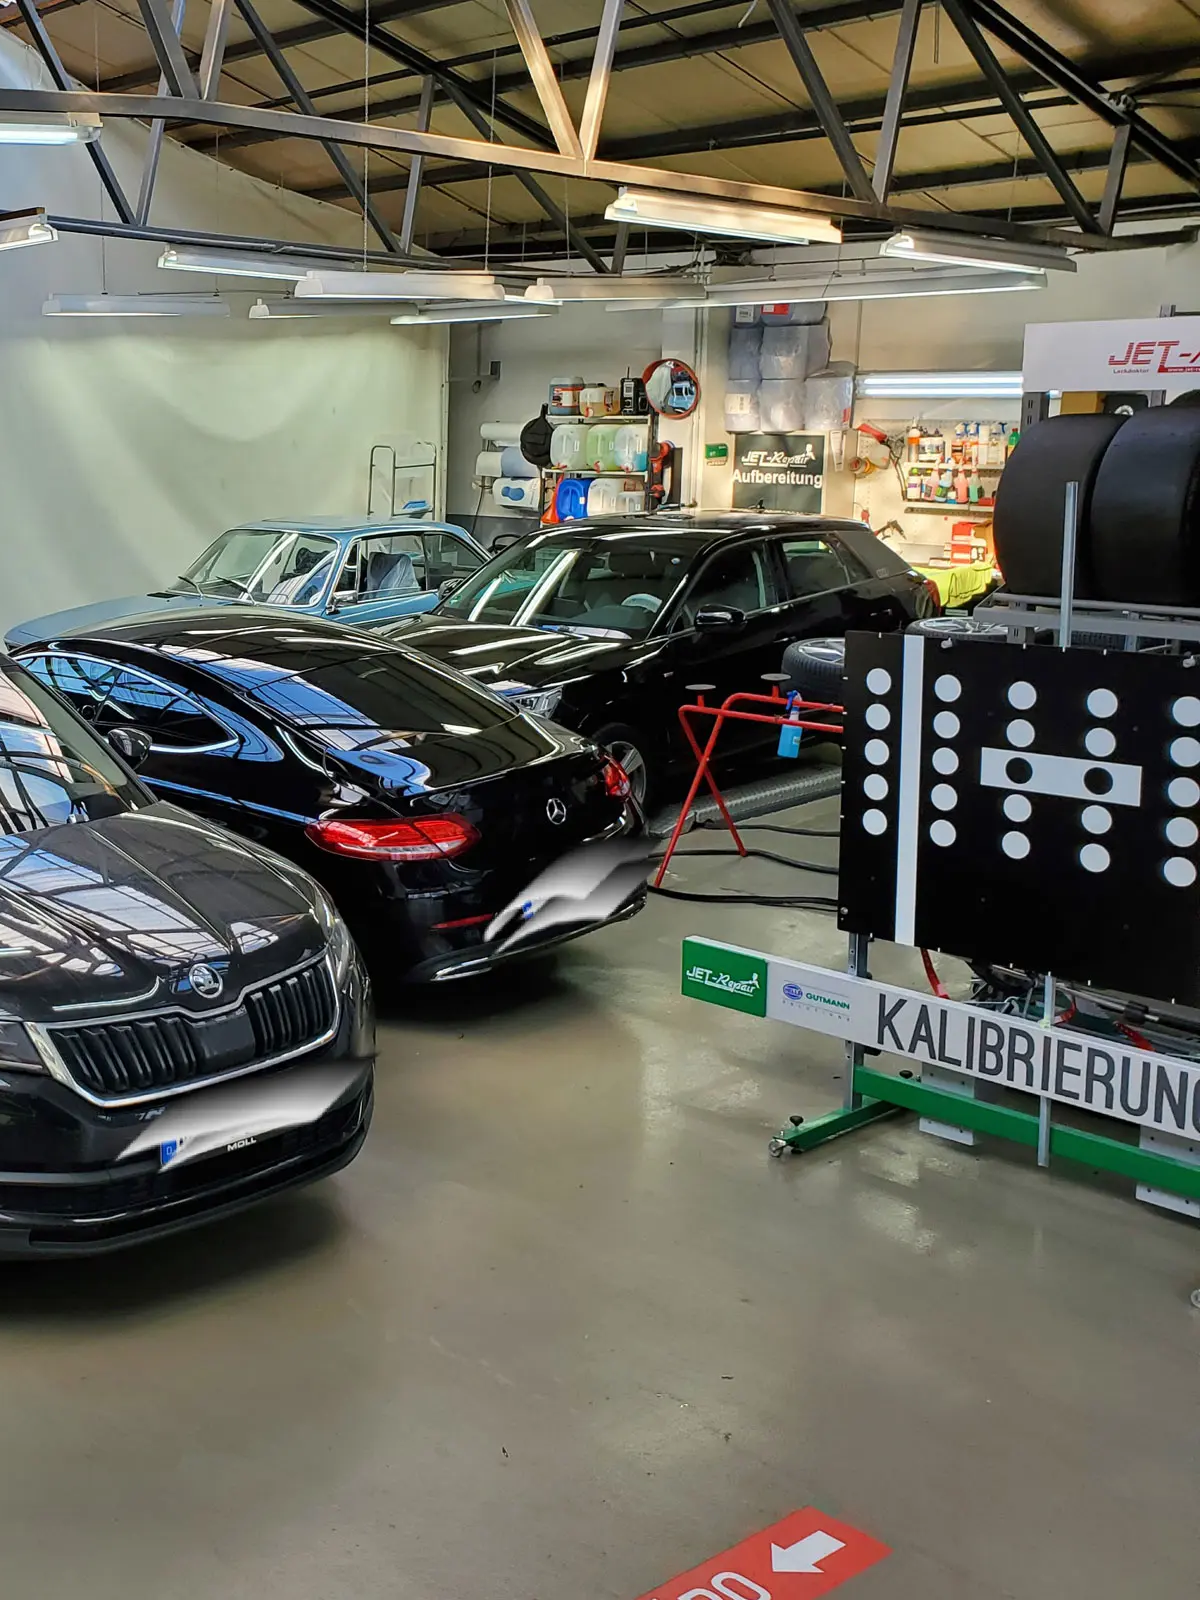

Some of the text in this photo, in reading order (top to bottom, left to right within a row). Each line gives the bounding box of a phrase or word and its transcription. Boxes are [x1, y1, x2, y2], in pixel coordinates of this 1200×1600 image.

[741, 450, 810, 468] JET-Repair
[732, 468, 823, 489] Aufbereitung
[686, 966, 756, 993] JET-Repair
[805, 992, 850, 1010] GUTMANN
